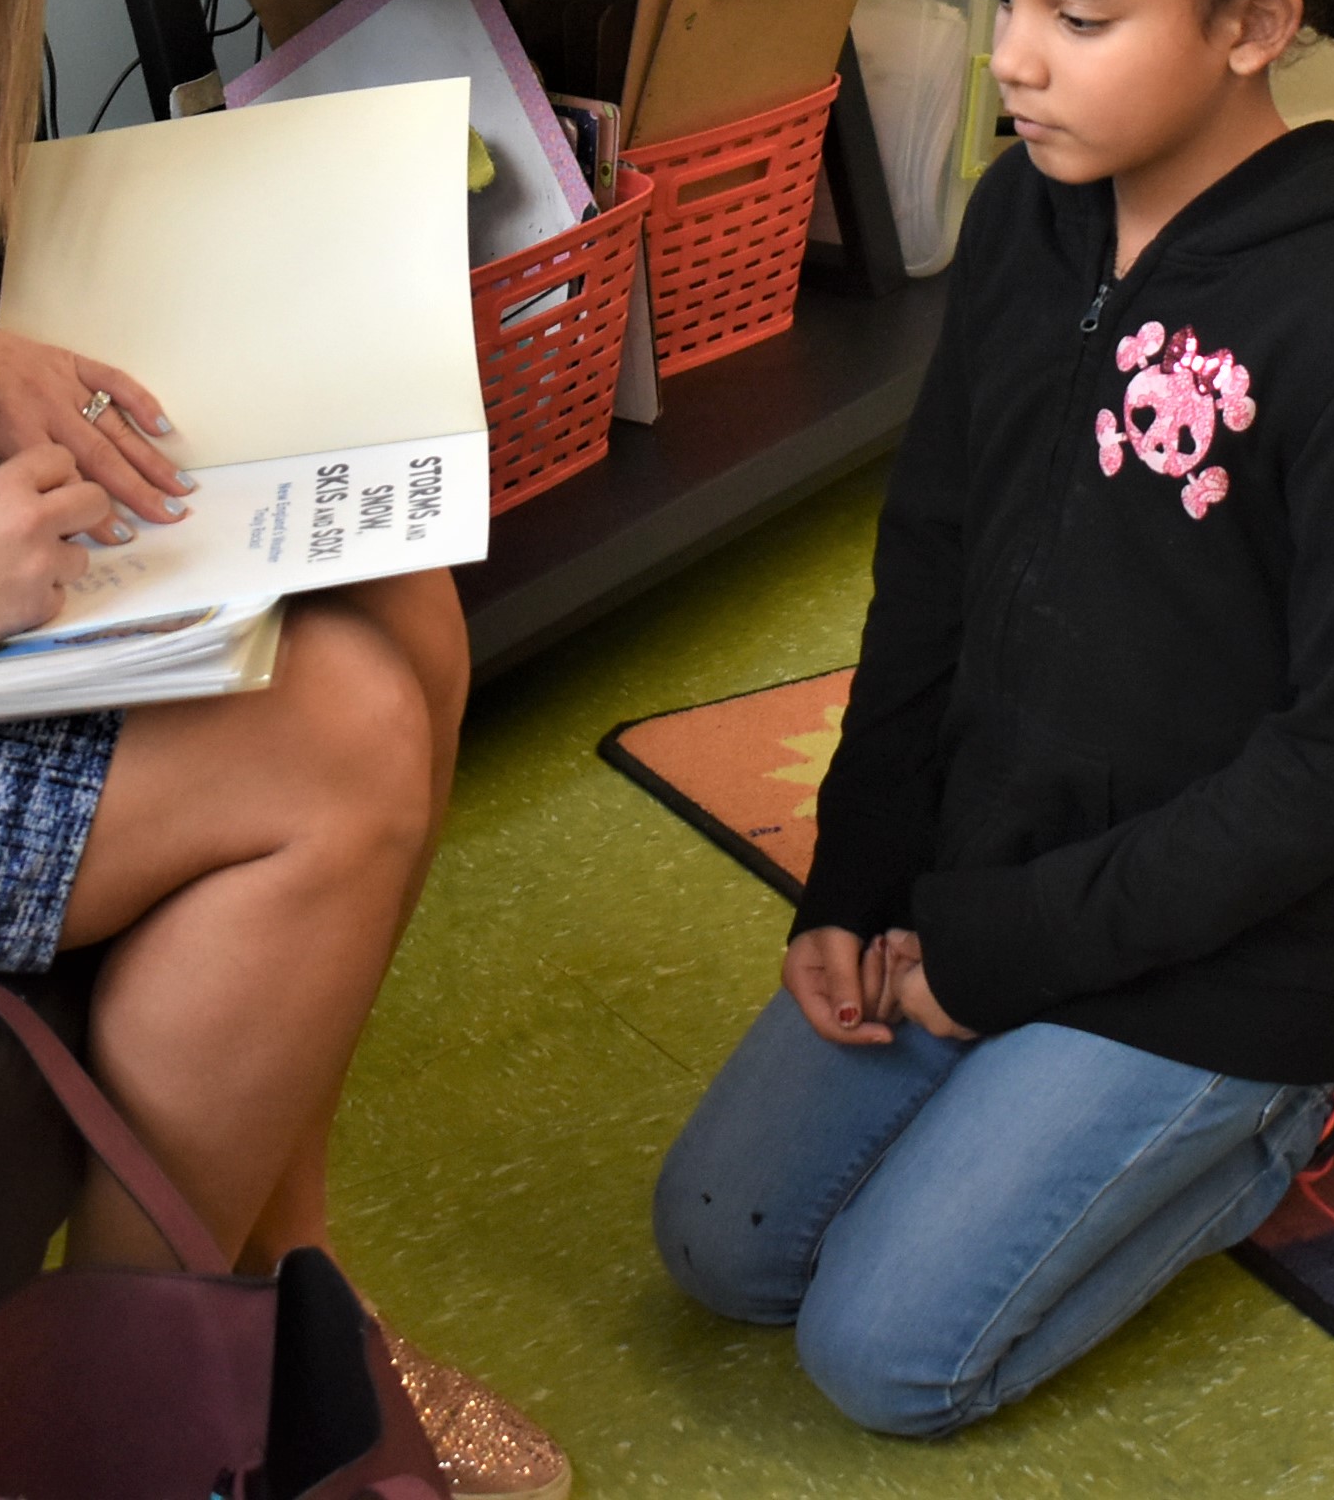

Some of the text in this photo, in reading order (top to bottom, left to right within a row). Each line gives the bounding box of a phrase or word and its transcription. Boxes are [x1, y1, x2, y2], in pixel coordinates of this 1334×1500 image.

[277, 481, 293, 501] New
[307, 462, 350, 563] SKIS AND SOX!
[356, 483, 395, 536] SNOW,
[406, 455, 442, 542] STORMS AND
